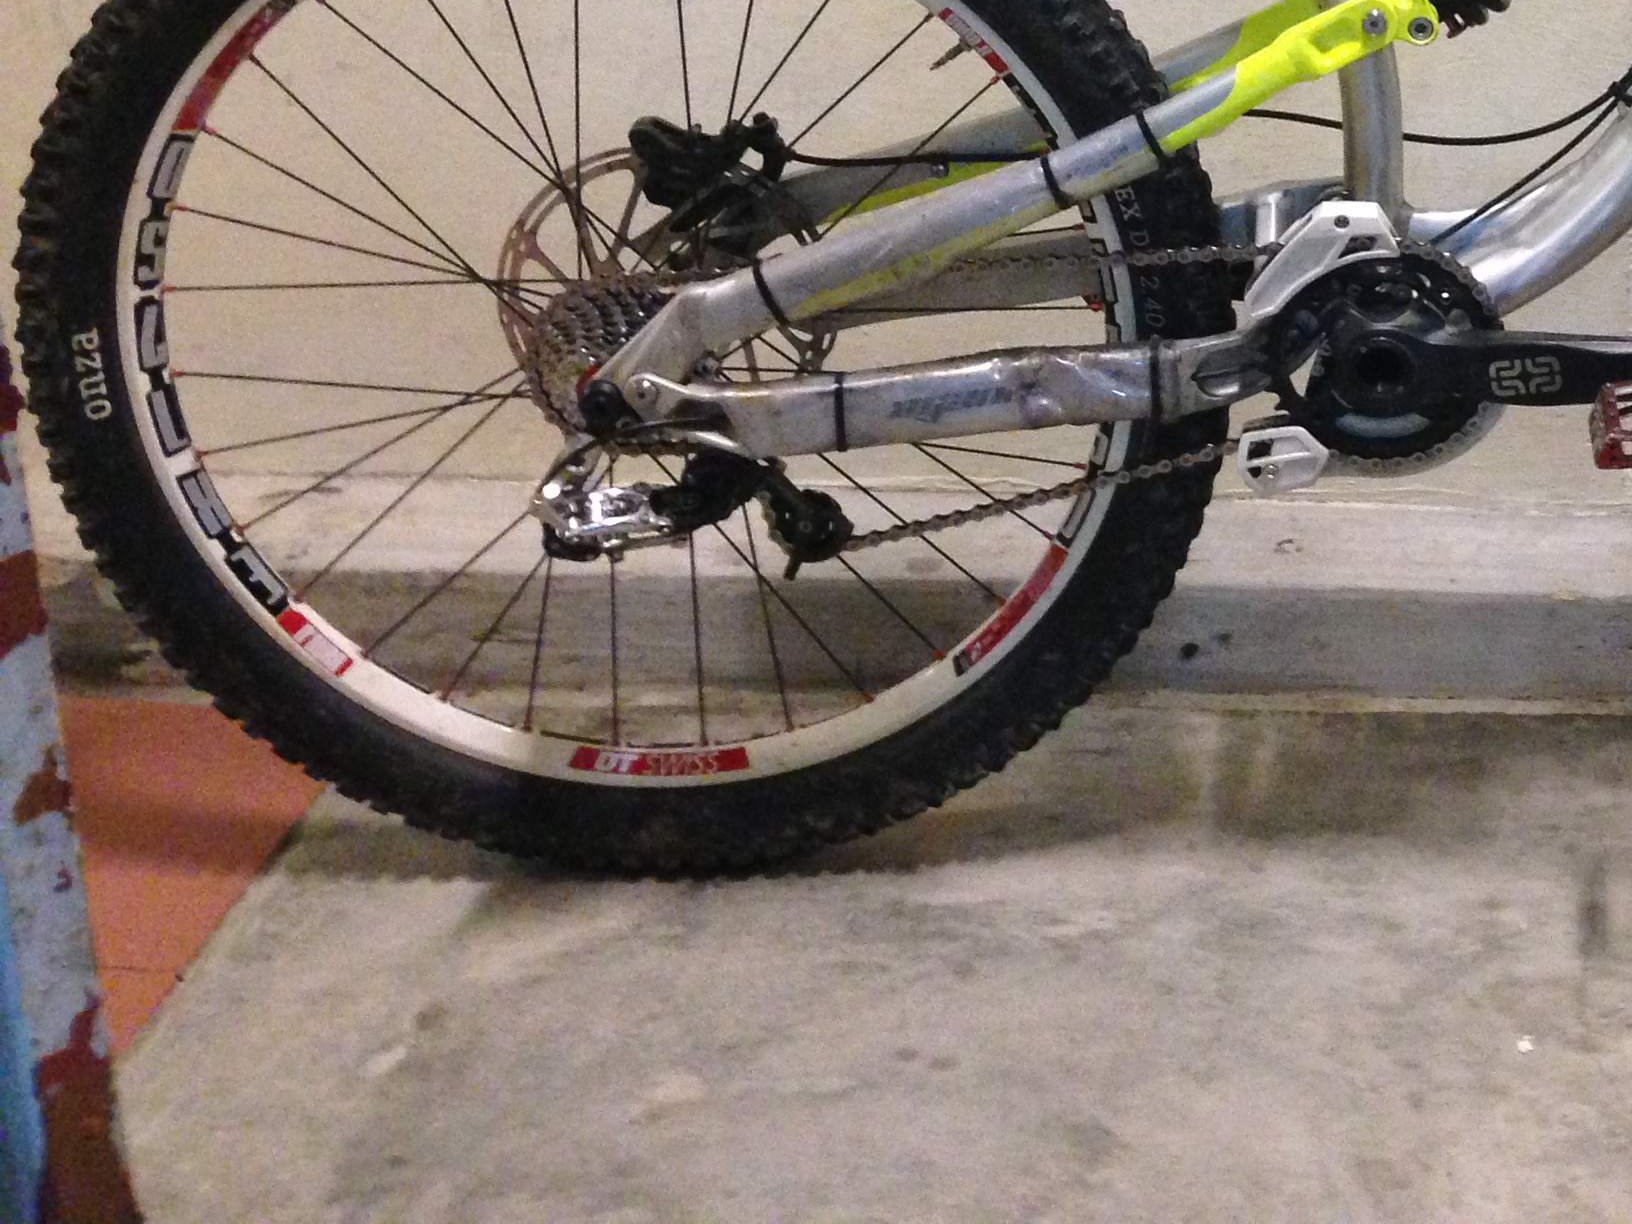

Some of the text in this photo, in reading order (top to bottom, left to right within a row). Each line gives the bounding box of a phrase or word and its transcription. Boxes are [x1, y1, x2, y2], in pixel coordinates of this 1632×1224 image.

[1114, 185, 1142, 222] EX
[72, 327, 113, 422] onza
[594, 752, 639, 773] DT
